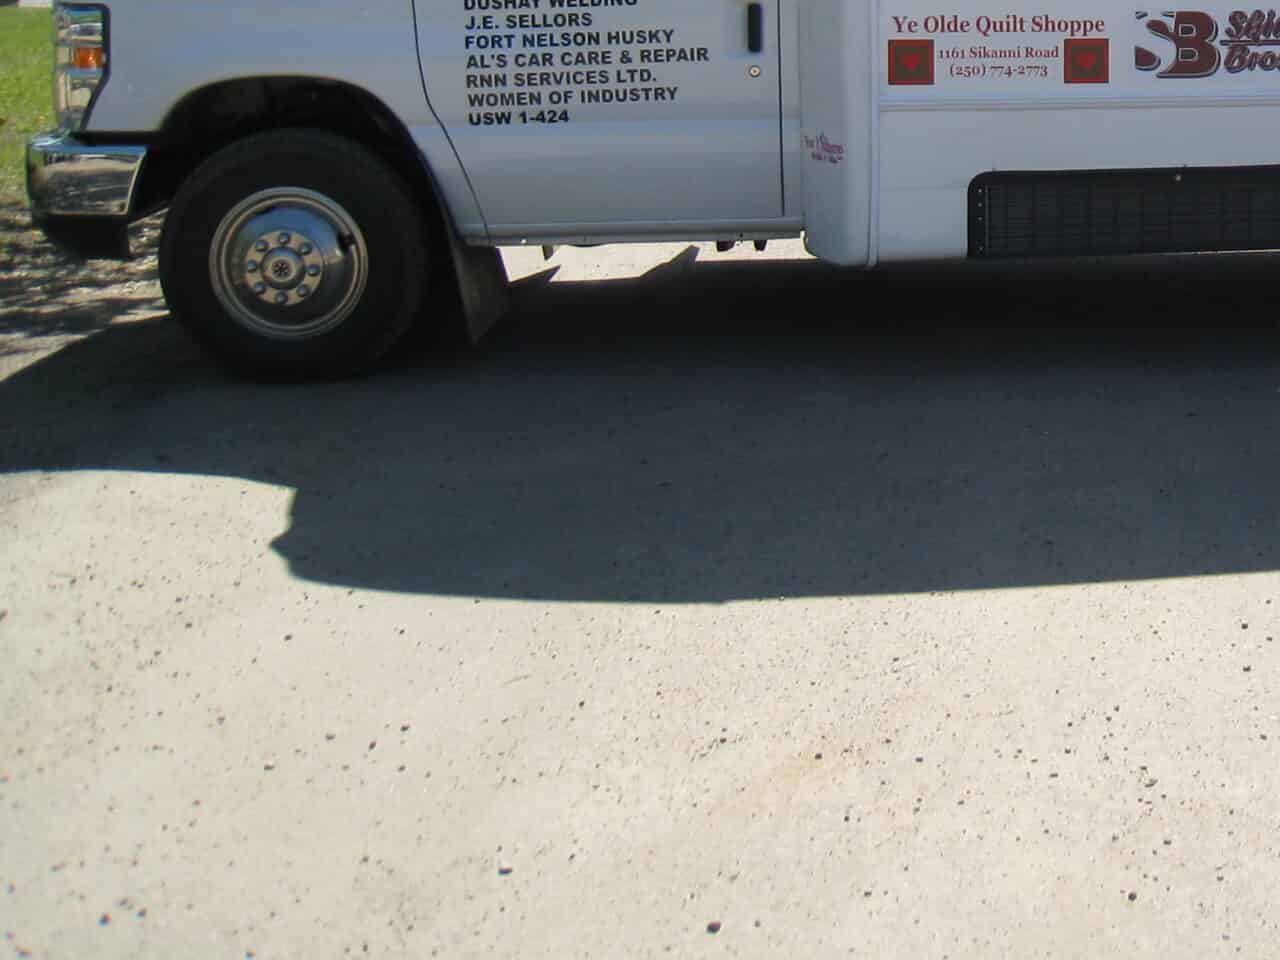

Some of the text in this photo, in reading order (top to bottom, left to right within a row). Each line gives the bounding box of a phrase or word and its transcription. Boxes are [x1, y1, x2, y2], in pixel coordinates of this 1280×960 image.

[464, 12, 593, 30] J.E. SELLORS
[893, 14, 1105, 37] Ye Olde Quilt Shoppe
[464, 29, 675, 50] FORT NELSON HUSKY
[466, 47, 710, 70] AL'S CAR CARE & REPAIR
[939, 46, 1060, 59] 1161 Sikanni Road
[466, 68, 657, 89] RNN SERVICES LTD.
[949, 64, 1048, 78] (250) 774-2773
[468, 86, 679, 108] WOMEN OF INDUSTRY
[468, 108, 571, 127] USW 1-424
